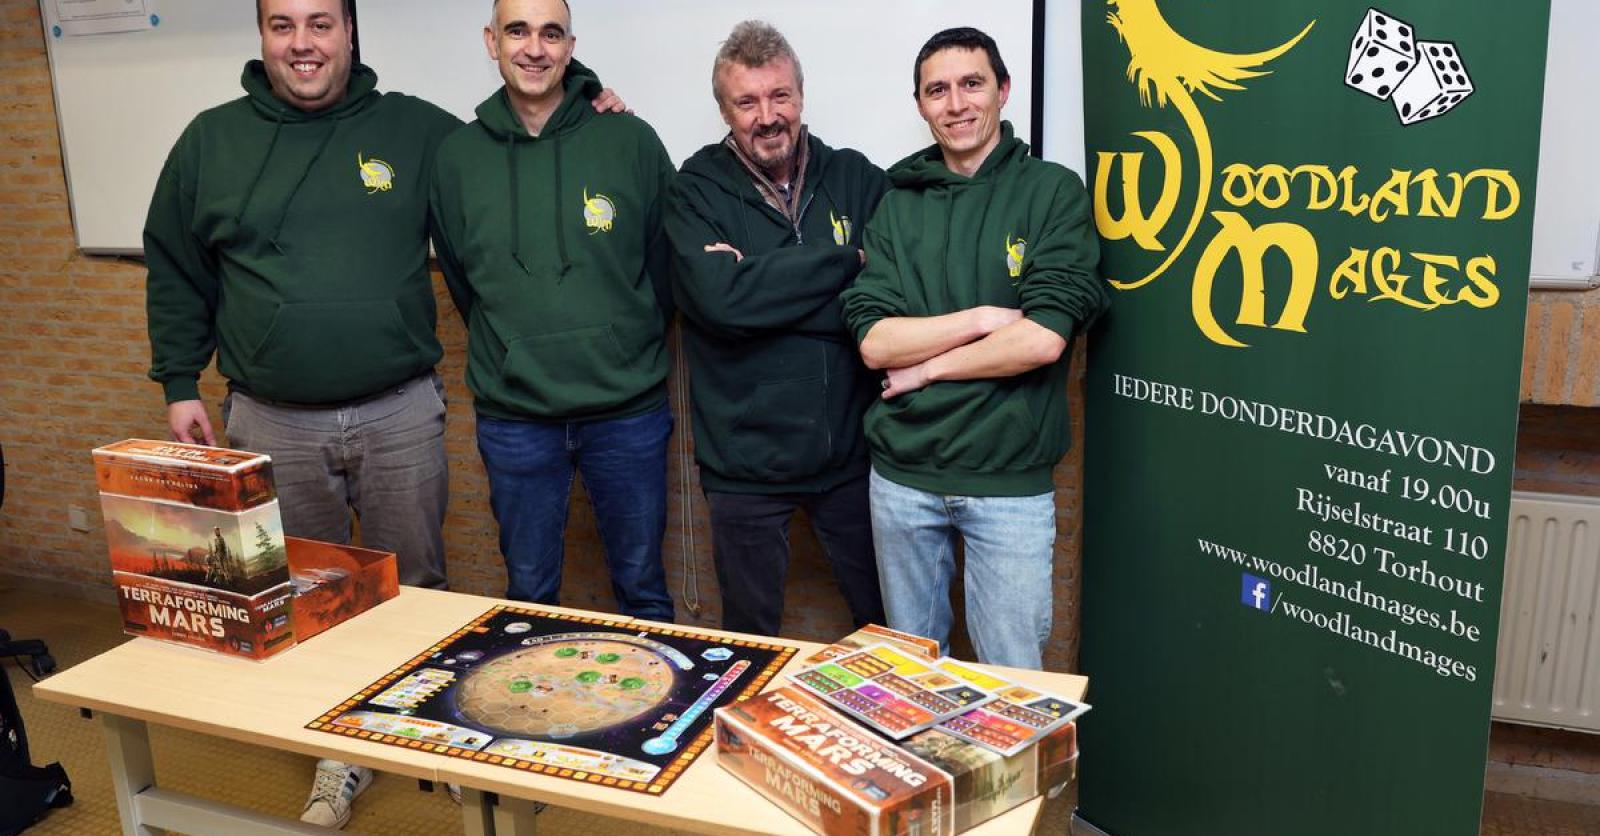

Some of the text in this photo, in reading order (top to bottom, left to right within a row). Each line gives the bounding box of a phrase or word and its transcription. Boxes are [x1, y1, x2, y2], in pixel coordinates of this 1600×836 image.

[1113, 373, 1496, 476] IEDERE DONDERDAGAVOND
[1296, 487, 1489, 560] Rijselstraat 110
[1324, 462, 1491, 519] vanaf 19.00u
[1198, 537, 1481, 643] www.woodlandmages.be
[1308, 531, 1485, 602] 8820 Torhout
[120, 584, 250, 624] TERRAFORMING
[148, 605, 225, 638] MARS
[768, 693, 928, 788] TERRAFORMING
[769, 715, 876, 776] MARS
[748, 744, 842, 816] TERRAFORMING
[765, 767, 821, 817] MARS
